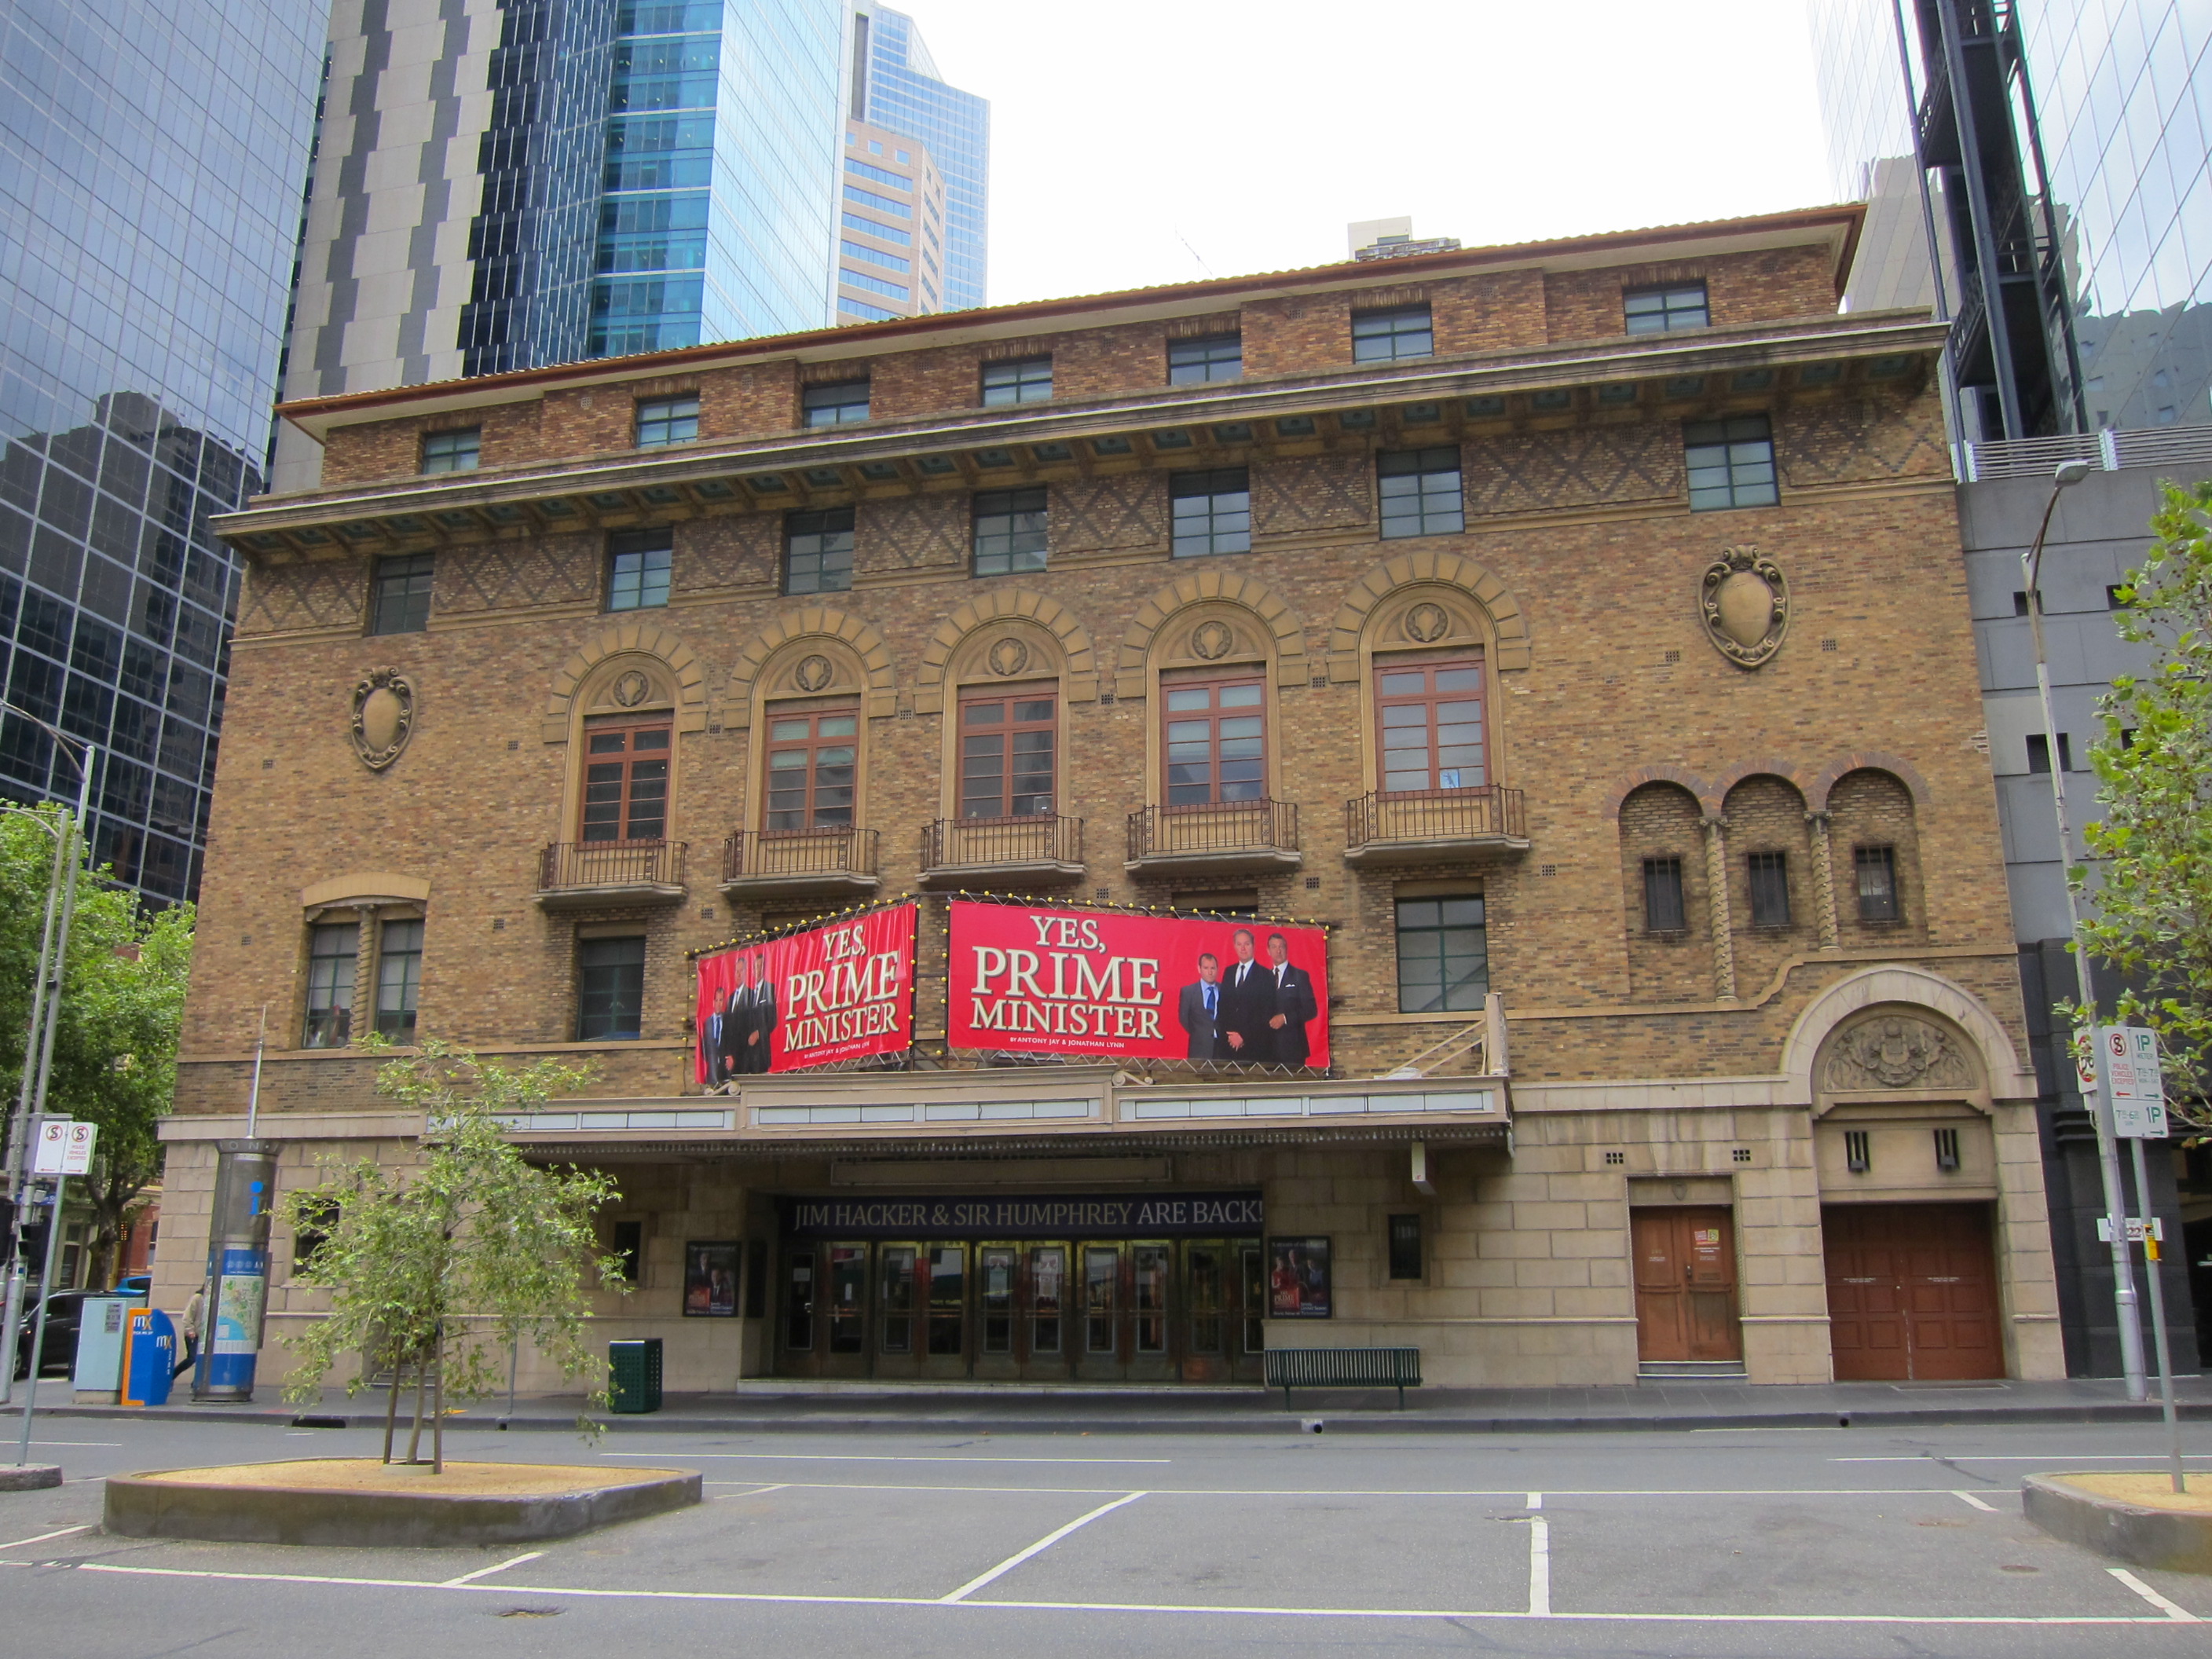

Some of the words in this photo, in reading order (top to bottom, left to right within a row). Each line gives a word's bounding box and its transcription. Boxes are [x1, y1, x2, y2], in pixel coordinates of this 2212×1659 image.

[823, 925, 866, 962] YES,
[1030, 915, 1106, 954] YES,
[786, 950, 899, 1020] PRIME
[971, 946, 1163, 1006] PRIME
[783, 1002, 899, 1053] MINISTER
[969, 997, 1165, 1041] MINISTER
[2136, 1035, 2150, 1051] 1P
[2146, 1106, 2162, 1123] 1P
[794, 1204, 829, 1231] JIM
[835, 1204, 928, 1226] HACKER
[932, 1204, 950, 1225] &
[954, 1204, 991, 1226] SIR
[997, 1203, 1133, 1226] HUMPHREY
[1137, 1202, 1186, 1225] ARE
[1192, 1199, 1262, 1224] BACK!
